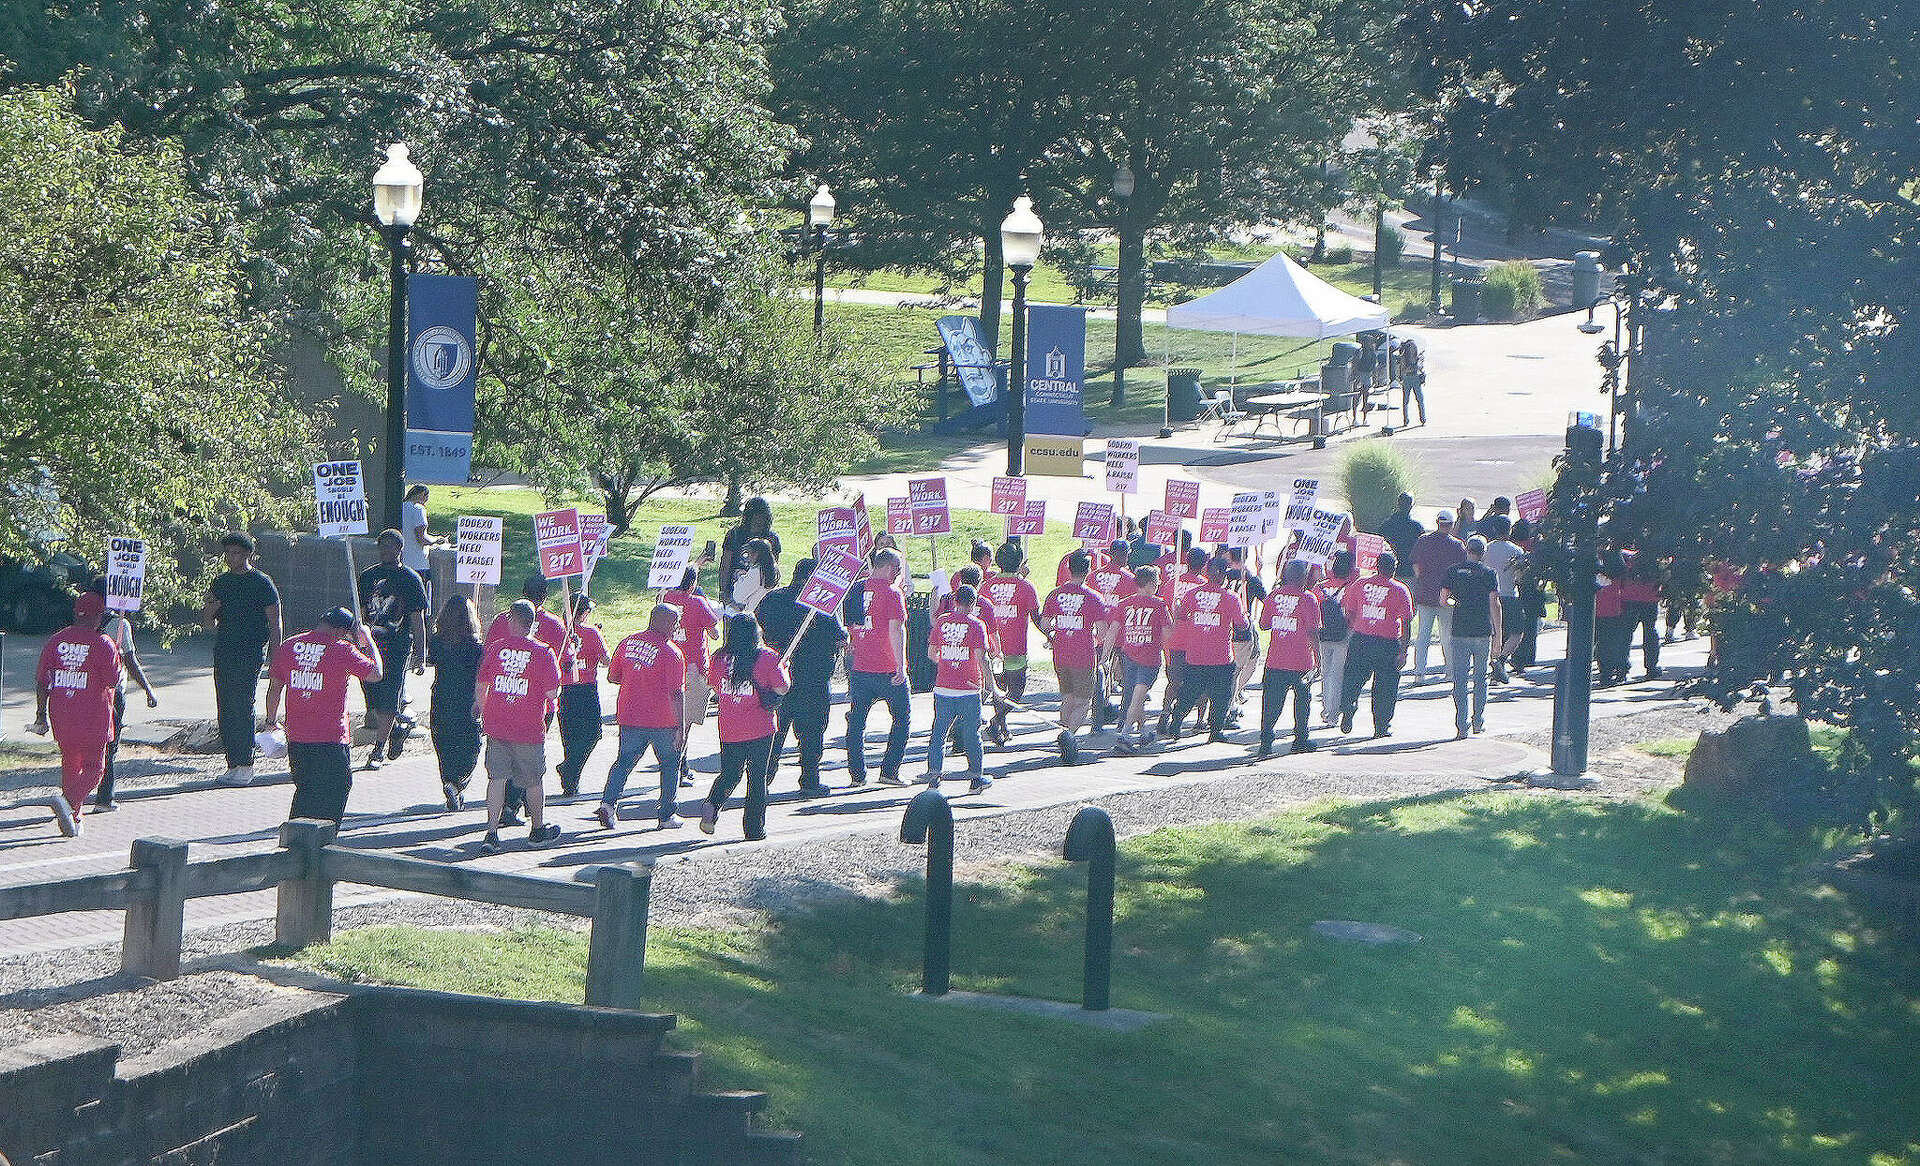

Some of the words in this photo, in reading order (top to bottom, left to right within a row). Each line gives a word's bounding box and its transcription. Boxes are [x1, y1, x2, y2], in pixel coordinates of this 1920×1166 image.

[1030, 379, 1080, 394] CENTRAL
[411, 444, 436, 457] EST.
[439, 446, 466, 458] 1849
[1030, 448, 1080, 457] ccsu.edu
[316, 462, 360, 478] ONE
[323, 476, 357, 487] JOB
[910, 481, 928, 496] WE
[1293, 479, 1319, 490] ONE
[911, 489, 943, 502] WORK.
[1294, 488, 1315, 496] JOB
[320, 499, 366, 524] ENOUGH
[998, 499, 1020, 512] 217
[1171, 501, 1191, 516] 217
[537, 515, 556, 529] WE
[819, 511, 837, 523] WE
[919, 513, 944, 531] 217
[1312, 509, 1344, 525] ONE
[539, 523, 576, 539] WORK.
[820, 520, 854, 533] WORK.
[893, 517, 912, 532] 217
[1015, 520, 1038, 533] 217
[1079, 523, 1103, 538] 217
[1313, 519, 1338, 531] JOB
[460, 531, 501, 542] WORKERS
[1153, 529, 1175, 543] 217
[1206, 527, 1225, 541] 217
[111, 538, 143, 553] ONE
[1299, 534, 1335, 557] ENOUGH
[114, 552, 140, 562] JOB
[458, 556, 464, 565] A
[549, 551, 576, 572] 217
[1361, 555, 1378, 568] 217
[470, 570, 487, 580] 217
[1096, 572, 1122, 583] ONE
[107, 574, 142, 599] ENOUGH
[990, 583, 1017, 593] ONE
[1363, 583, 1390, 594] ONE
[806, 585, 837, 607] 217
[1057, 593, 1086, 603] ONE
[1194, 590, 1222, 602] ONE
[1273, 593, 1300, 605] ONE
[1125, 605, 1154, 627] 217
[940, 622, 970, 633] ONE
[1126, 634, 1153, 645] UNION
[57, 641, 91, 656] ONE
[293, 641, 327, 656] ONE
[498, 648, 532, 662] ONE
[54, 669, 88, 690] ENOUGH
[290, 669, 324, 691] ENOUGH
[494, 674, 529, 696] ENOUGH
